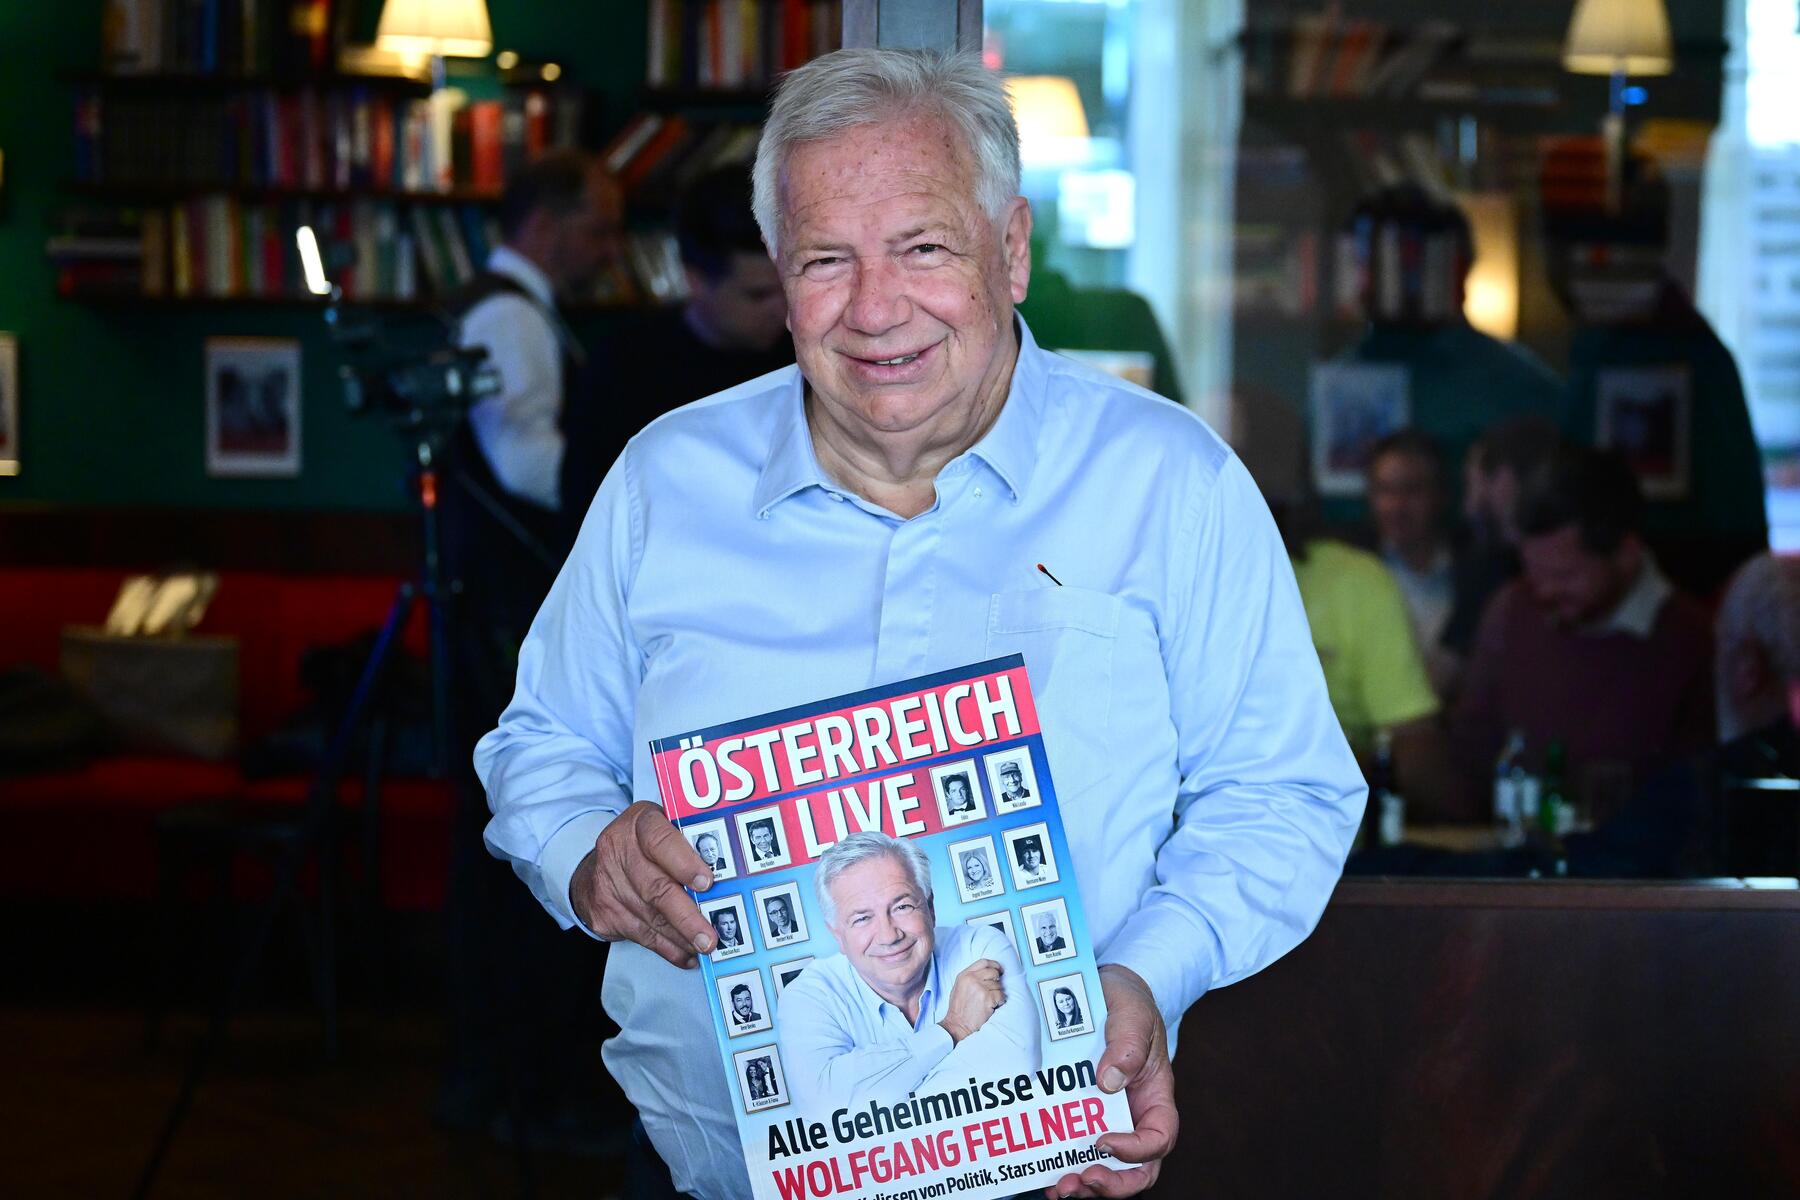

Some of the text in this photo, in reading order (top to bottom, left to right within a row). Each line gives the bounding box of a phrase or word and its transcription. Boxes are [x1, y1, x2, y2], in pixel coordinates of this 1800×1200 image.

[677, 674, 1023, 809] ÖSTERREICH
[794, 773, 926, 858] LIVE
[768, 1059, 1097, 1160] Alle Geheimnisse von
[772, 1097, 1109, 1200] WOLFGANG FELLNER
[918, 1182, 946, 1200] von
[946, 1168, 998, 1194] Politik,
[998, 1160, 1036, 1182] Stars
[1040, 1151, 1064, 1173] und
[1065, 1144, 1112, 1167] Medie
